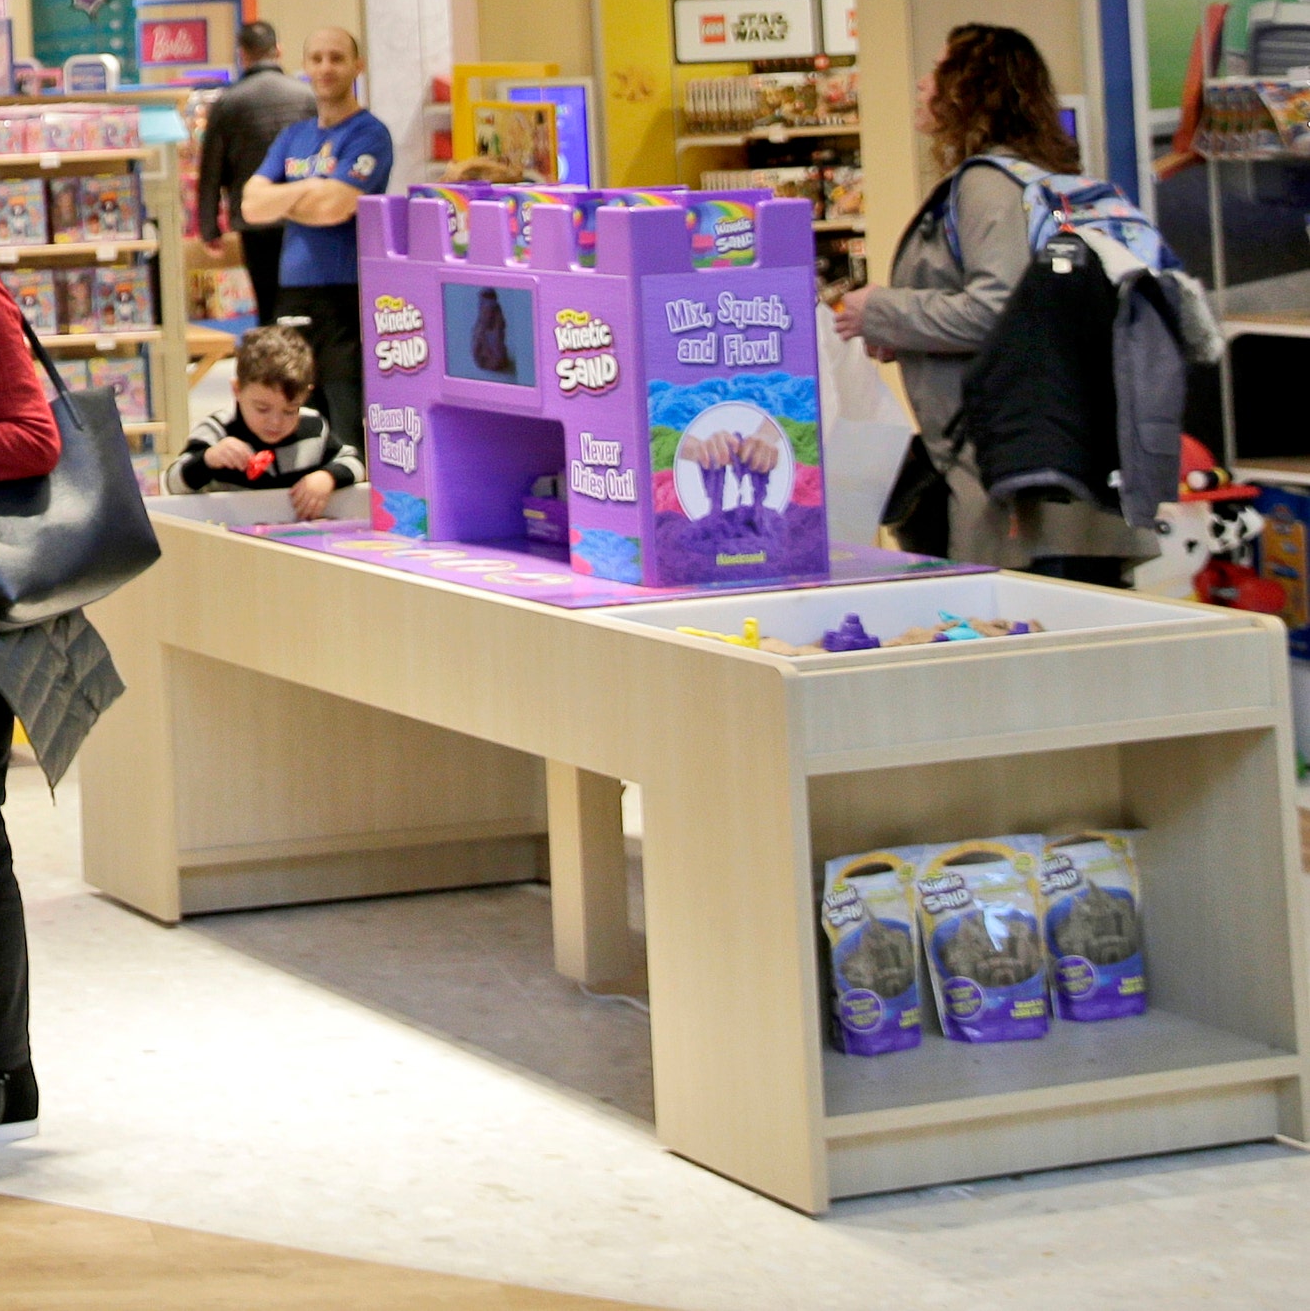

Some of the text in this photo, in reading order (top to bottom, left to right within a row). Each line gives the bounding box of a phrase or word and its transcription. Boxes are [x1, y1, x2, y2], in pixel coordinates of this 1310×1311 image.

[730, 24, 790, 42] WARS
[736, 12, 786, 26] STAR
[665, 291, 792, 333] Mix, Squish,
[677, 331, 781, 366] and Flow!
[368, 403, 422, 444] Cleans Up
[379, 433, 418, 473] Easily!
[580, 432, 622, 466] Never
[571, 460, 638, 502] Dries Out!
